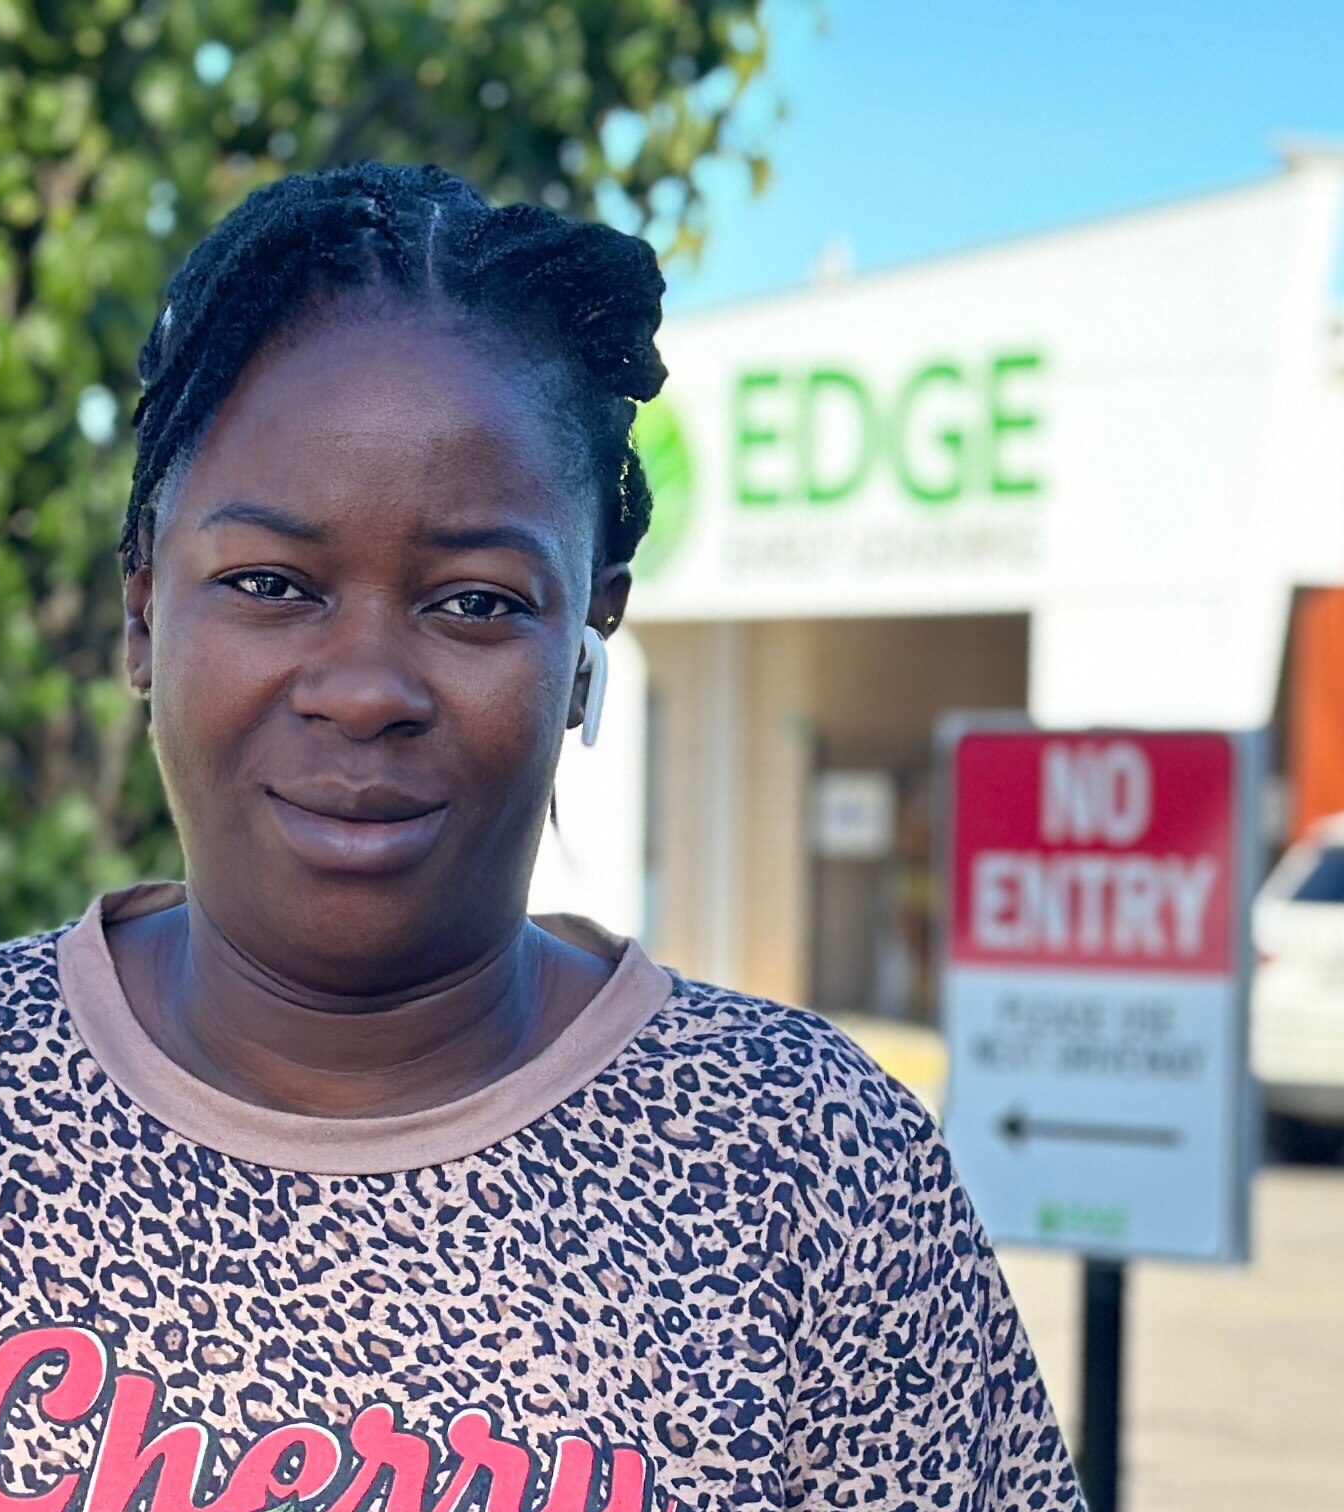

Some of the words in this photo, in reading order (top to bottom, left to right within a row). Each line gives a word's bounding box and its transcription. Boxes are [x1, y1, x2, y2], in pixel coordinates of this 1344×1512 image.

[730, 352, 1046, 508] EDGE
[1039, 739, 1152, 848] NO
[969, 849, 1221, 957] ENTRY
